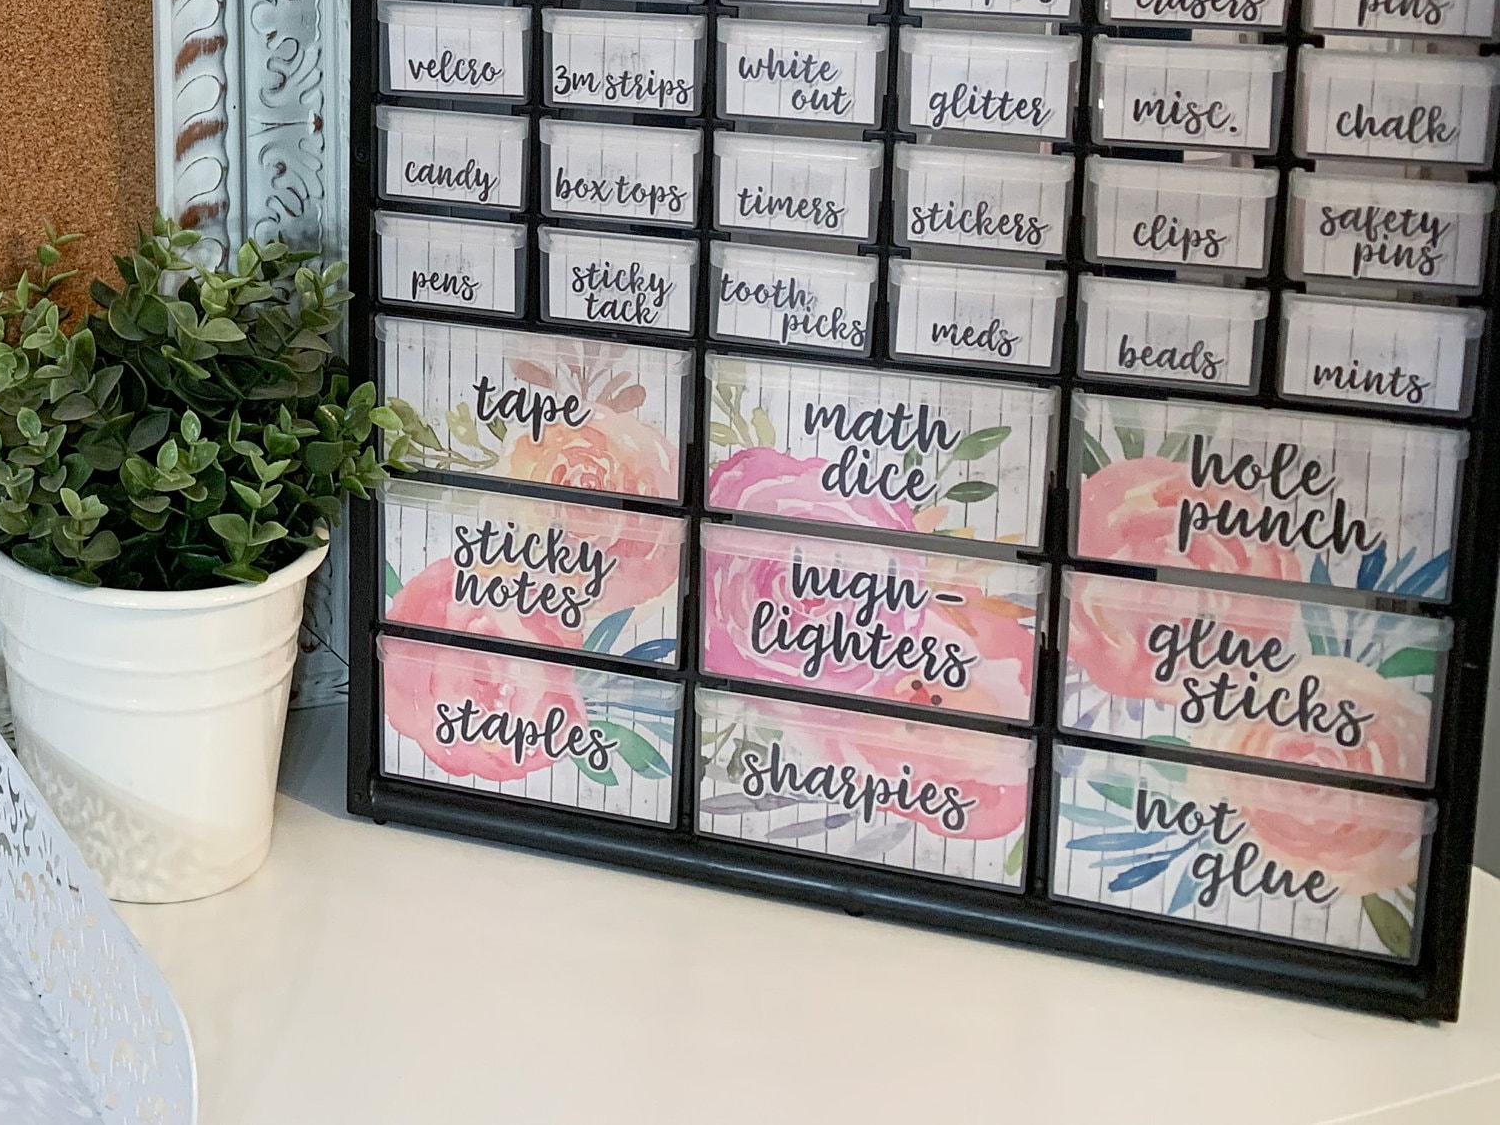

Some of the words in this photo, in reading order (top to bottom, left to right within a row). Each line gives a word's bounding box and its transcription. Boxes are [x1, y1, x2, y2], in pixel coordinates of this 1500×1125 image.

[408, 50, 504, 85] velcro
[554, 66, 601, 96] 3m
[605, 68, 696, 107] strips
[739, 48, 839, 82] white
[791, 85, 854, 117] out
[928, 83, 1052, 127] glitter
[1132, 87, 1238, 134] misc.
[1335, 104, 1458, 145] chalk
[404, 159, 500, 200] candy
[555, 167, 613, 202] box
[615, 176, 688, 213] tops
[737, 189, 846, 229] timers
[910, 200, 1049, 246] stickers
[1320, 205, 1450, 250] safety
[1132, 215, 1227, 260] clips
[1352, 230, 1442, 277] pins
[412, 267, 480, 302] pens
[571, 261, 675, 305] sticky
[719, 272, 810, 309] tooth
[585, 292, 660, 325] tack
[781, 307, 867, 345] picks
[931, 319, 1018, 357] meds
[1118, 334, 1222, 380] beads
[1313, 360, 1430, 402] mints
[472, 376, 592, 442] tape
[803, 400, 961, 455] math
[821, 446, 939, 503] dice
[1190, 435, 1337, 497] hole
[1177, 497, 1386, 552] punch
[454, 521, 617, 597] sticky
[453, 572, 592, 629] notes
[791, 547, 964, 622] high-
[751, 602, 976, 689] lighters
[1148, 619, 1296, 681] glue
[1181, 672, 1374, 748] sticks
[435, 698, 618, 771] staples
[743, 743, 976, 832] sharpies
[1135, 788, 1246, 844] hot
[1191, 843, 1340, 908] glue
